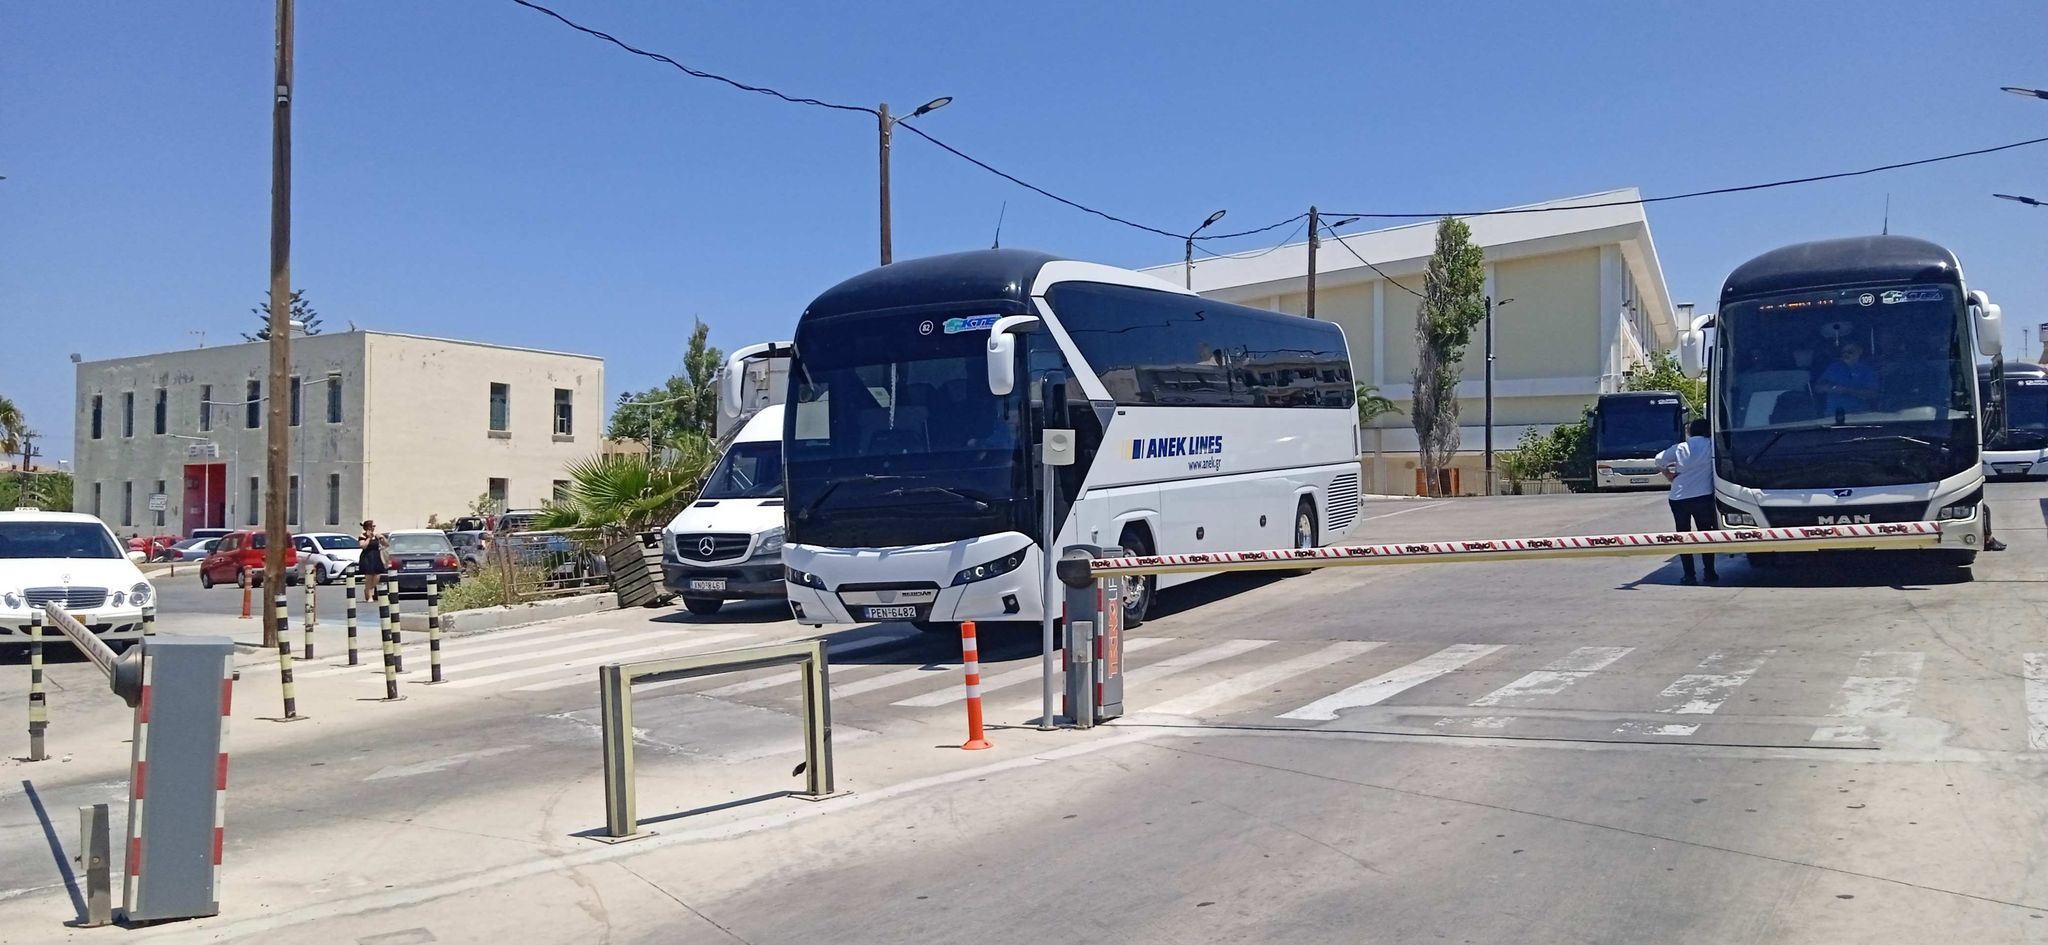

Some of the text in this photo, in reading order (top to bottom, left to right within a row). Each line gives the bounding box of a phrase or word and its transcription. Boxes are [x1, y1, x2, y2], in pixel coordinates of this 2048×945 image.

[1146, 436, 1222, 458] ANEK LINES
[1188, 456, 1222, 471] www.anek.gr
[1818, 514, 1870, 525] MAN
[1107, 576, 1119, 679] TECNOLIF
